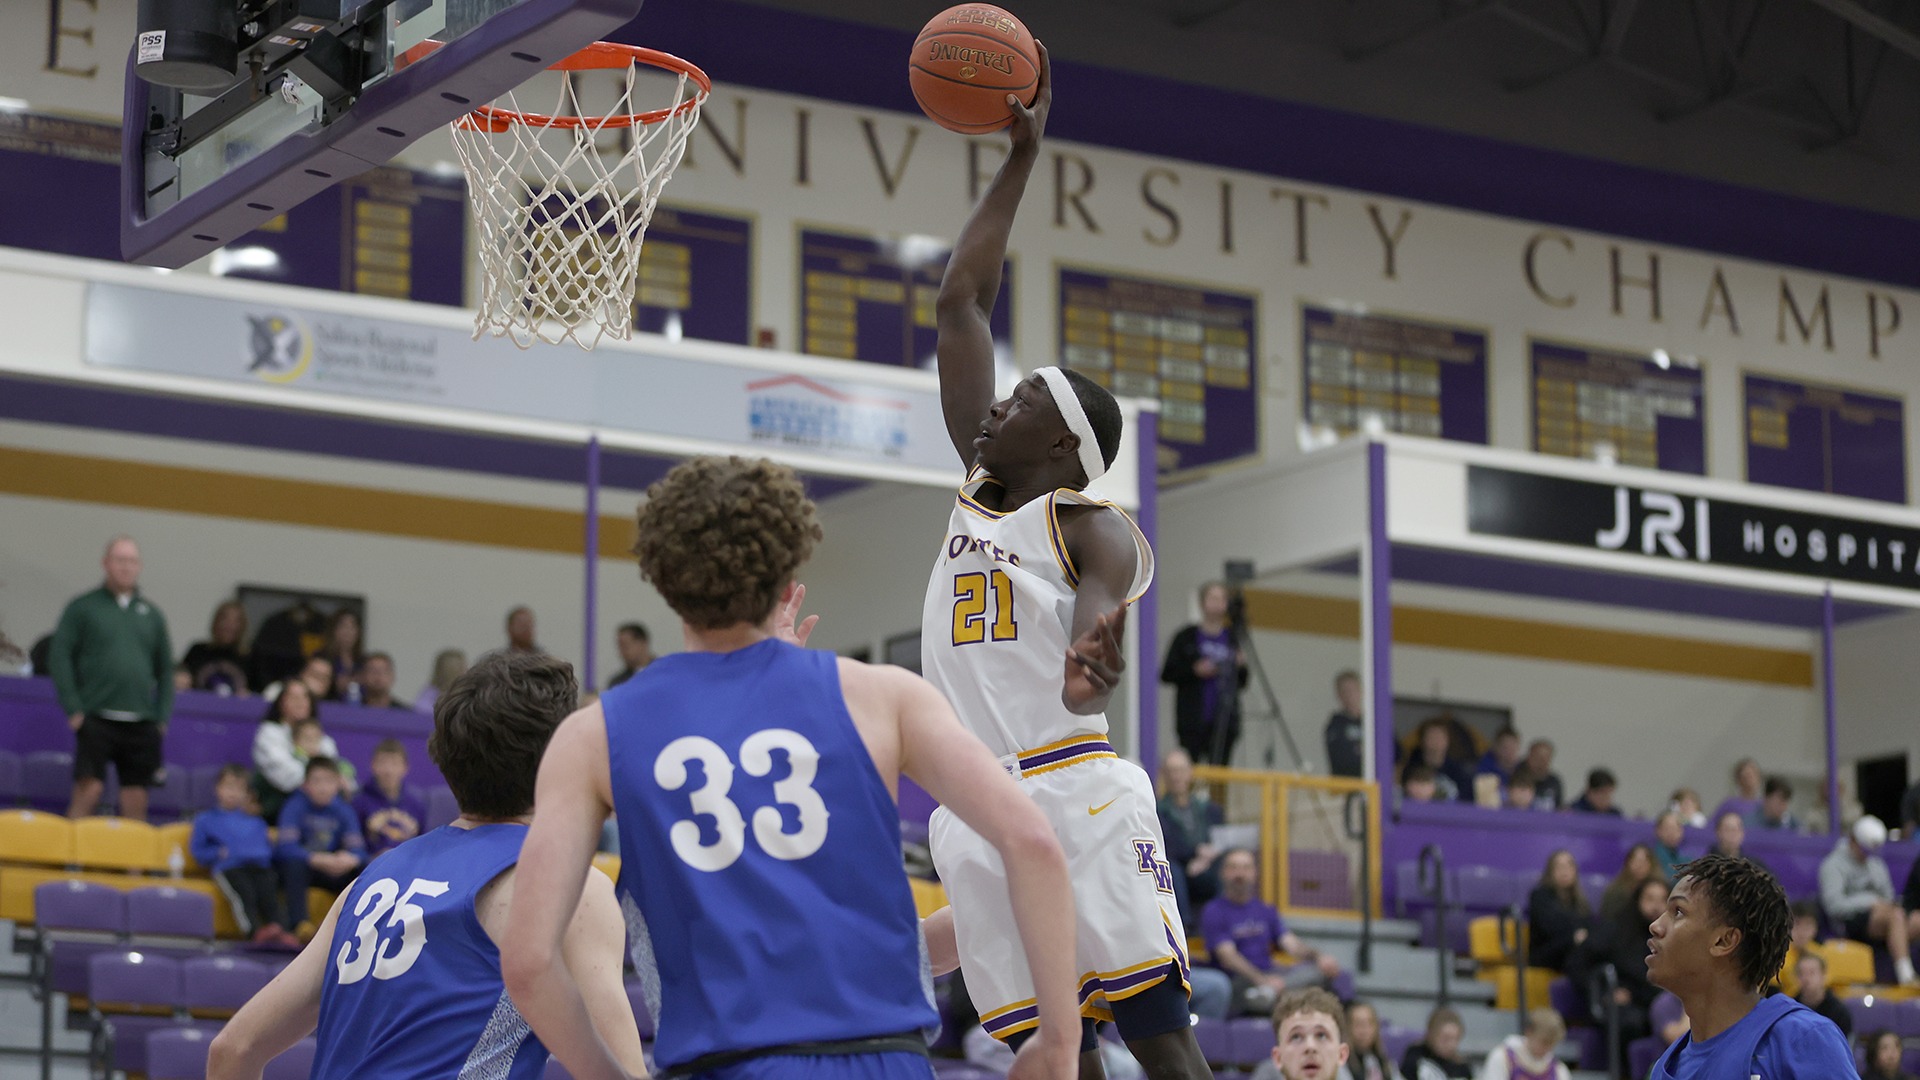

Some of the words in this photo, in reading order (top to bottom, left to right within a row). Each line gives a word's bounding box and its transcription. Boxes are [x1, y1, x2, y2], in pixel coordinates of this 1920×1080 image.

[141, 35, 162, 46] PSS
[929, 41, 1015, 76] SPALDING
[566, 72, 1413, 280] UNIVERSITY
[1522, 230, 1902, 360] CHAMP
[1596, 486, 1711, 562] JRI
[952, 568, 1018, 647] 21
[654, 728, 830, 872] 33
[1132, 840, 1173, 894] KW
[336, 878, 450, 985] 35
